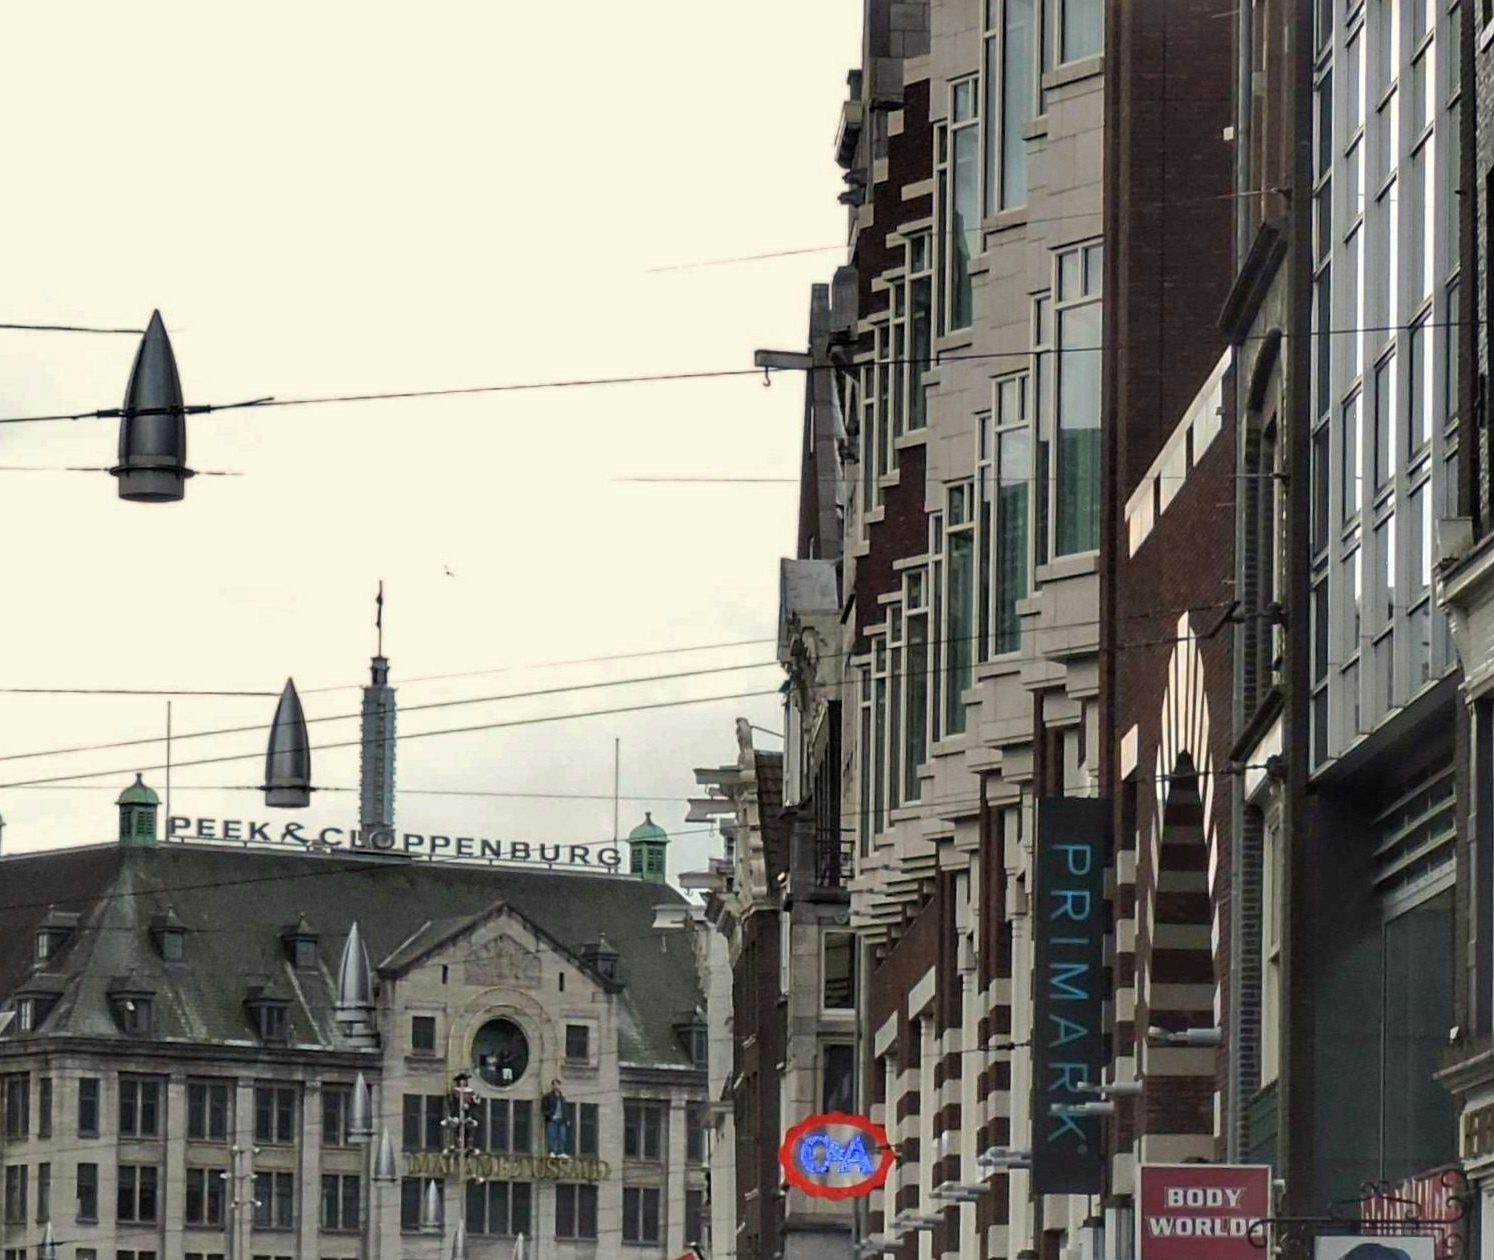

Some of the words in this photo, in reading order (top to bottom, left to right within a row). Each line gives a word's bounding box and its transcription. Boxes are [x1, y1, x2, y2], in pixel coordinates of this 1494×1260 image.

[168, 815, 272, 842] PEEK
[282, 821, 309, 844] &
[318, 826, 623, 868] CLOPPENBURG
[1048, 843, 1092, 1142] PRIMARK
[800, 1133, 874, 1174] C&A
[1167, 1188, 1242, 1207] BODY
